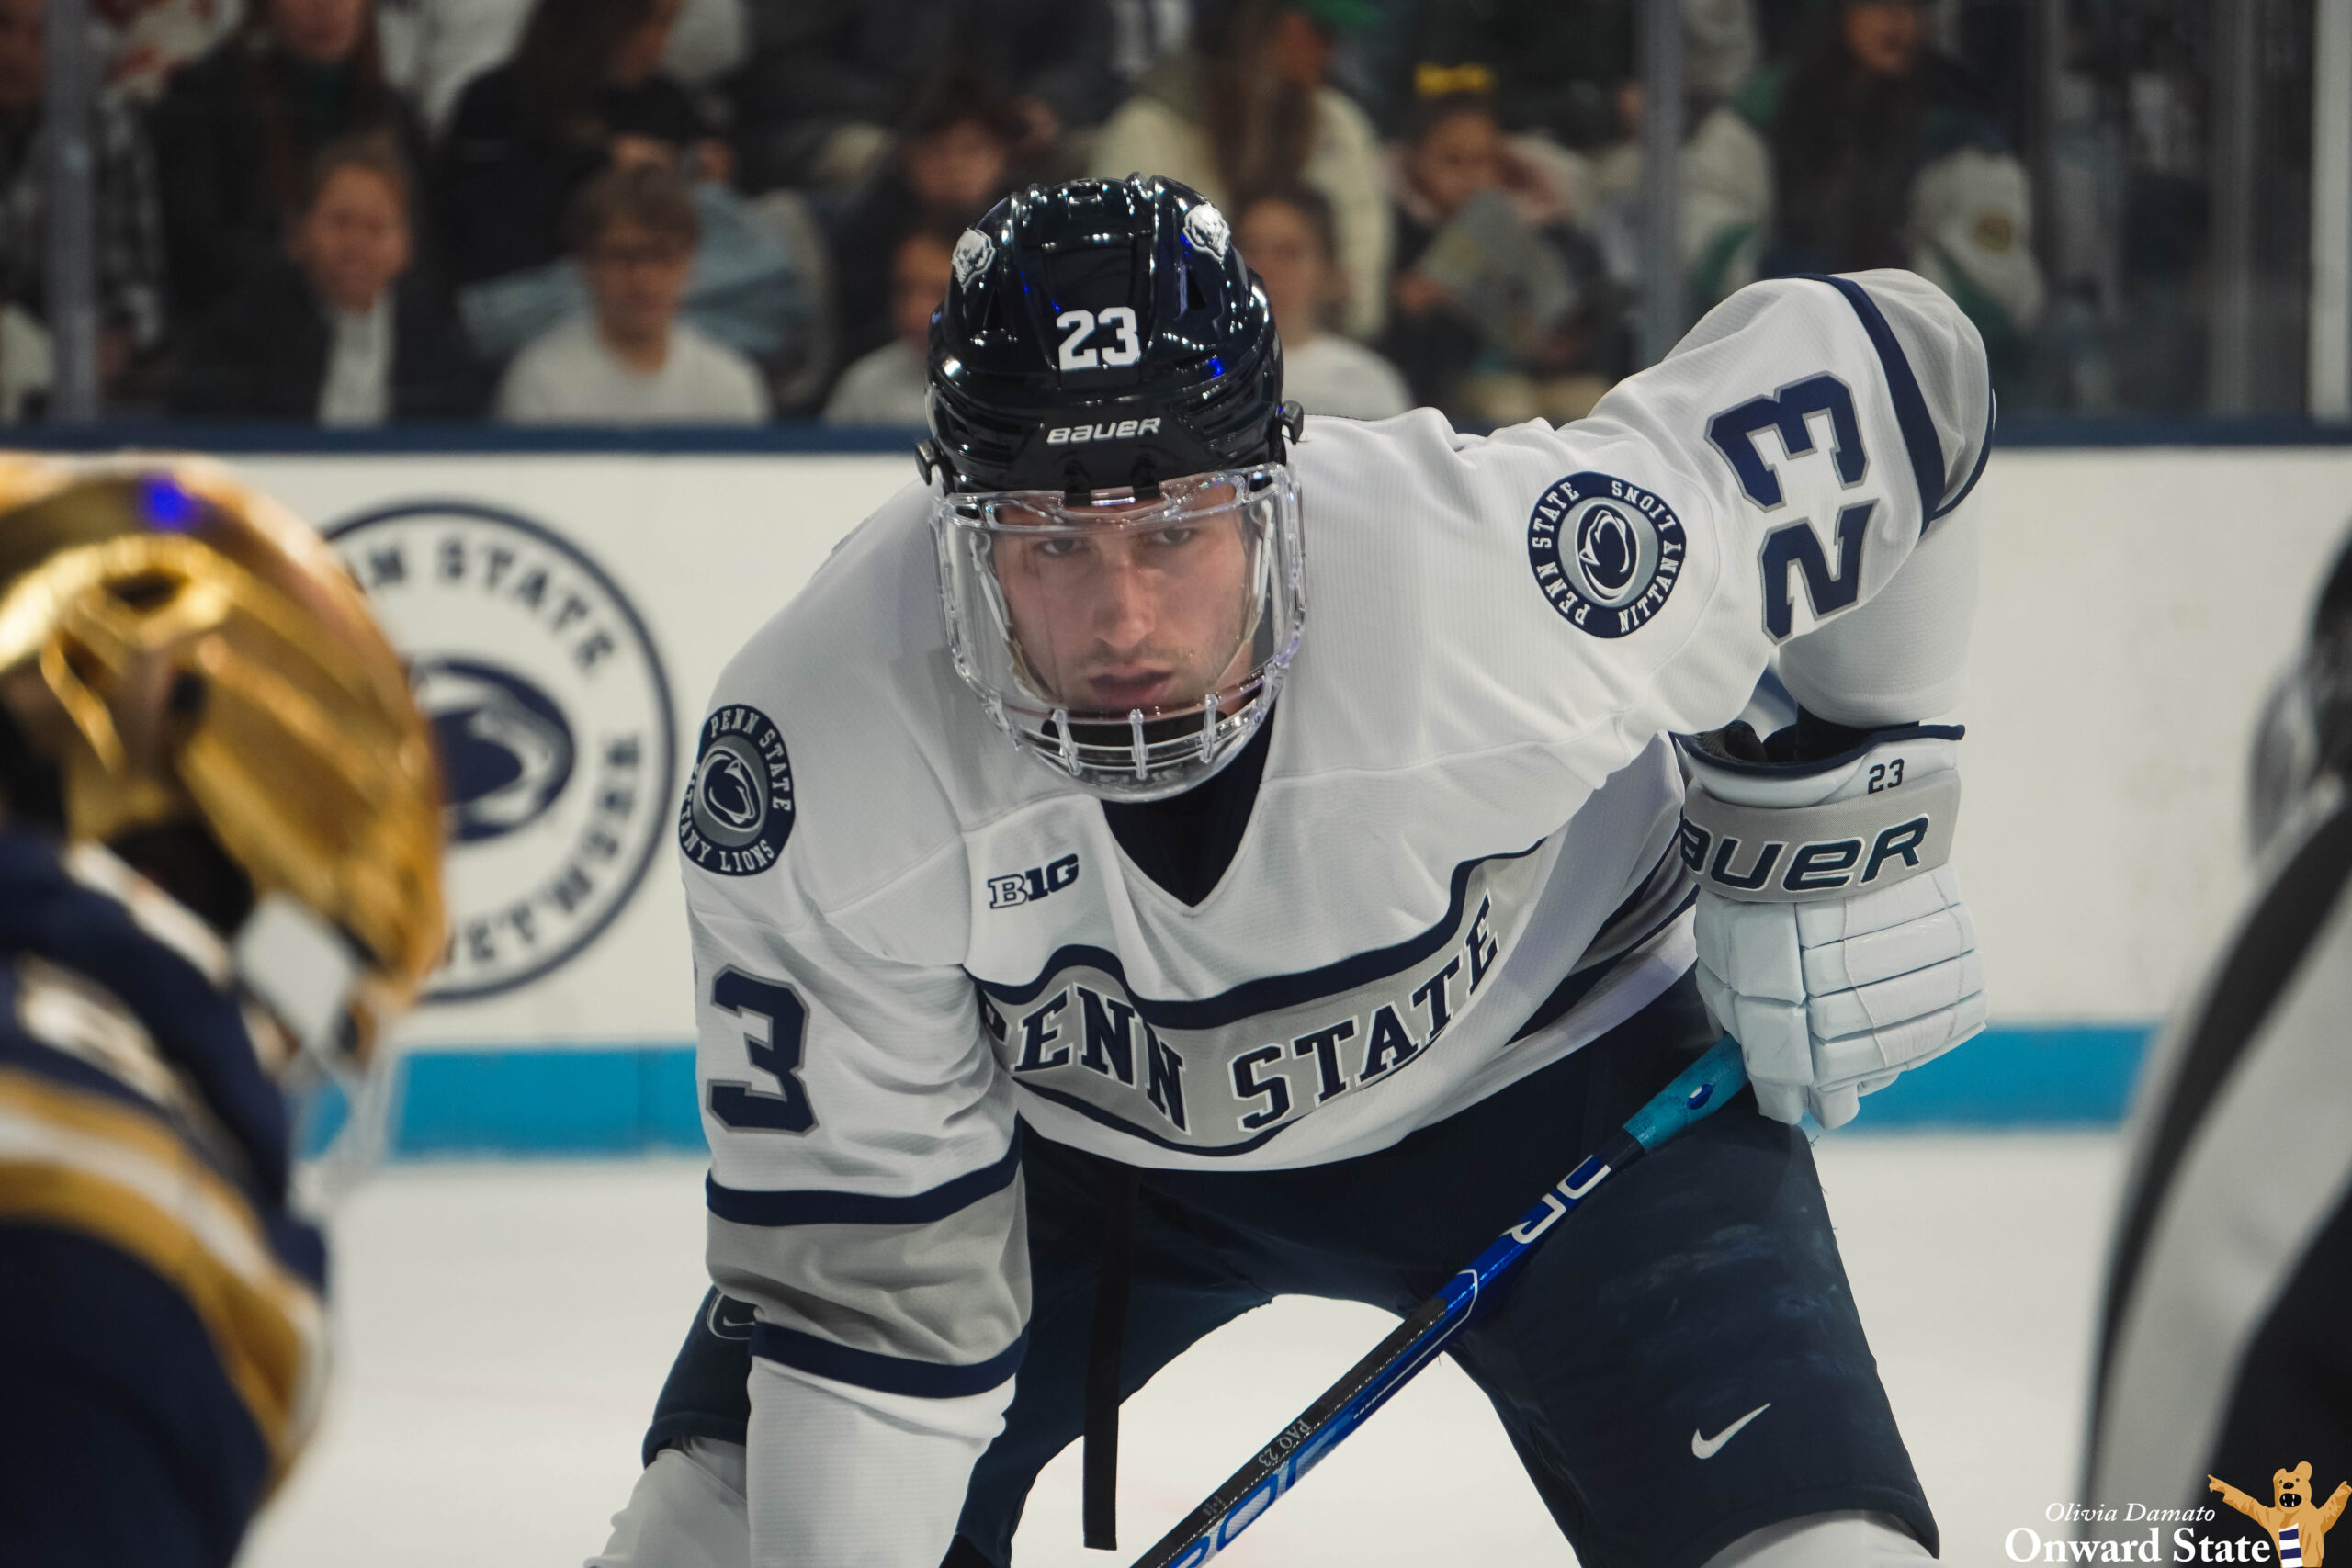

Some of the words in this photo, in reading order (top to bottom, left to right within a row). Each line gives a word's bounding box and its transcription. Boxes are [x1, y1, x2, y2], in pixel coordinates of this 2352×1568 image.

[1056, 306, 1141, 372] 23
[1046, 417, 1162, 446] BAUER
[1532, 481, 1580, 549] STATE
[1611, 480, 1677, 532] LIONS
[1704, 370, 1881, 646] 23
[1535, 561, 1591, 626] PENN
[1618, 540, 1682, 634] NITTANY
[710, 708, 760, 738] PENN
[758, 728, 792, 812] STATE
[1868, 758, 1905, 795] 23
[719, 839, 775, 873] LIONS
[1680, 814, 1929, 893] AUER
[1226, 887, 1500, 1133] STATE
[694, 962, 820, 1137] 3
[1258, 1447, 1279, 1468] 23
